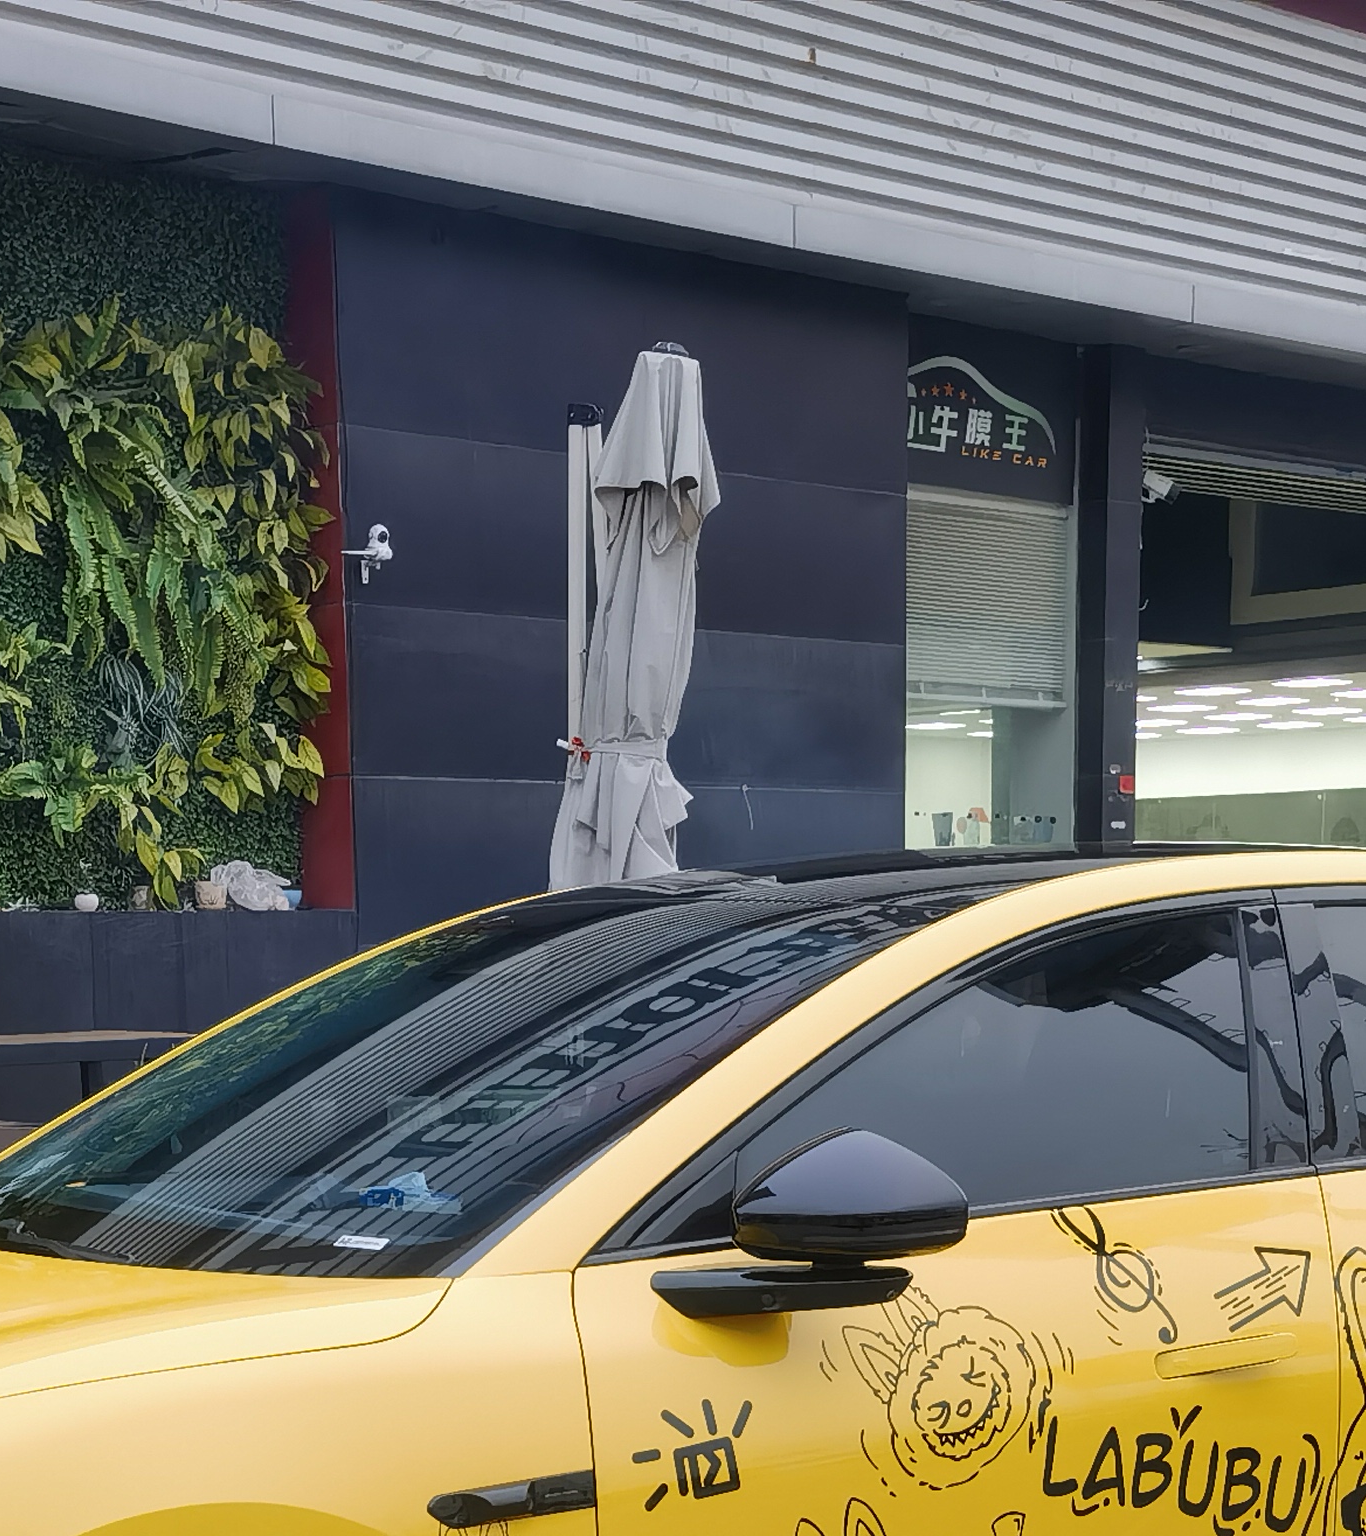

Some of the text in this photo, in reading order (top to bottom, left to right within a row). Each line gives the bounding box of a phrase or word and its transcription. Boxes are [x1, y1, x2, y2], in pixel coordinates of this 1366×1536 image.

[961, 446, 1048, 468] LIKE CAR
[1042, 1414, 1308, 1534] LABUBU
